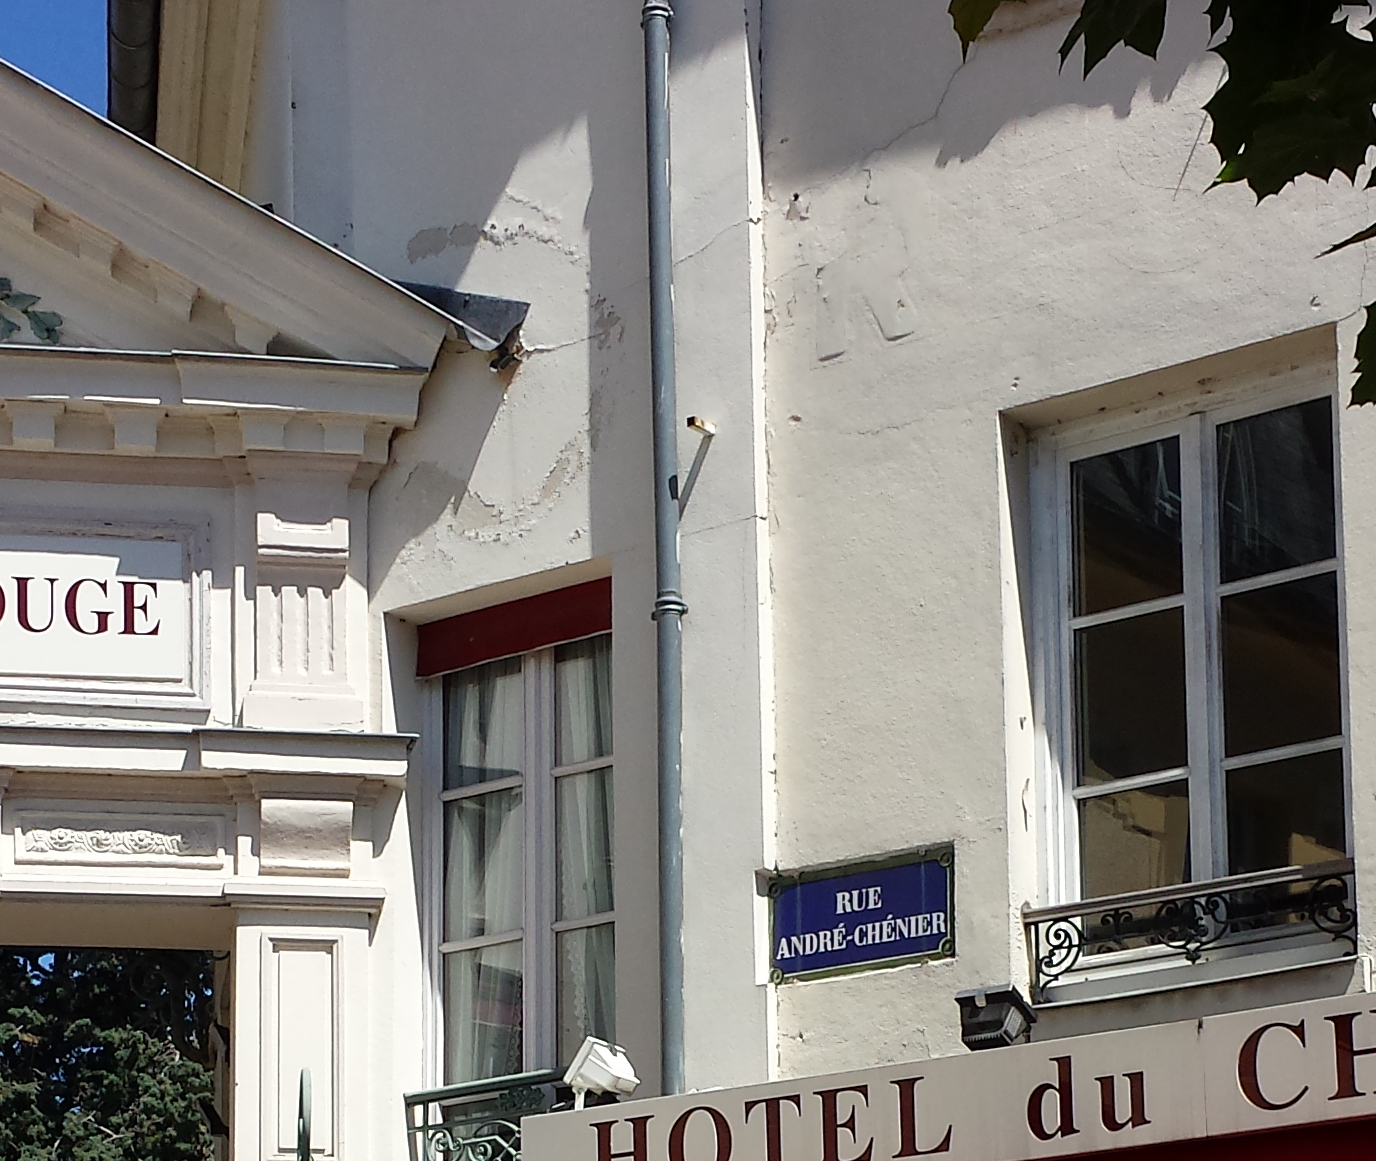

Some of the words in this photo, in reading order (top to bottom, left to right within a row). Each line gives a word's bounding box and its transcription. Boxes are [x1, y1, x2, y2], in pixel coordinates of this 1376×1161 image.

[835, 886, 883, 915] RUE
[776, 911, 946, 960] ANDRÉ-CHÉNIER
[1026, 1055, 1152, 1141] du
